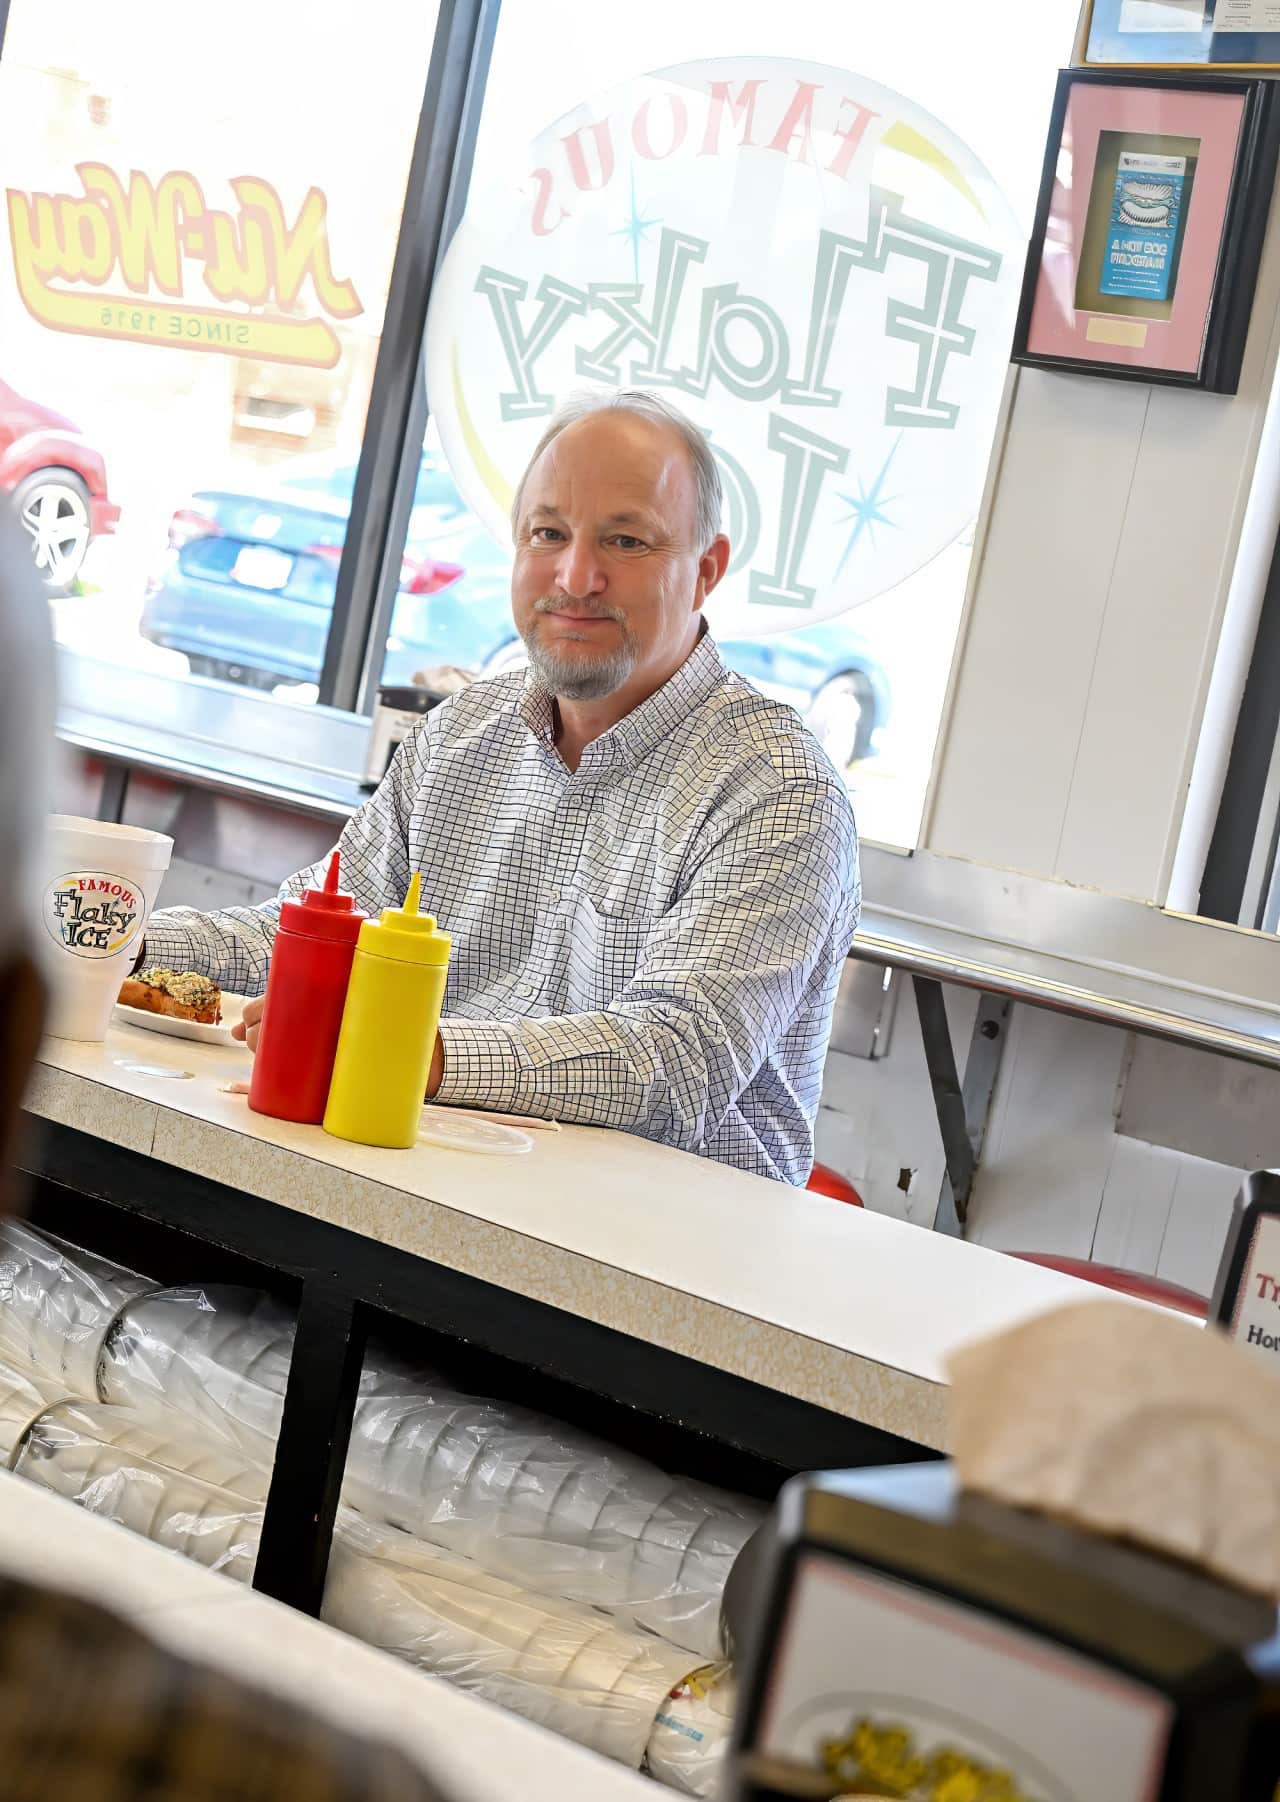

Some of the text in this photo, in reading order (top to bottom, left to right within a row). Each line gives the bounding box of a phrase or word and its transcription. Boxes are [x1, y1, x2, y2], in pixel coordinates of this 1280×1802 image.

[78, 879, 136, 909] FAMOUS
[53, 888, 136, 934] Flaky
[65, 922, 112, 950] ICE
